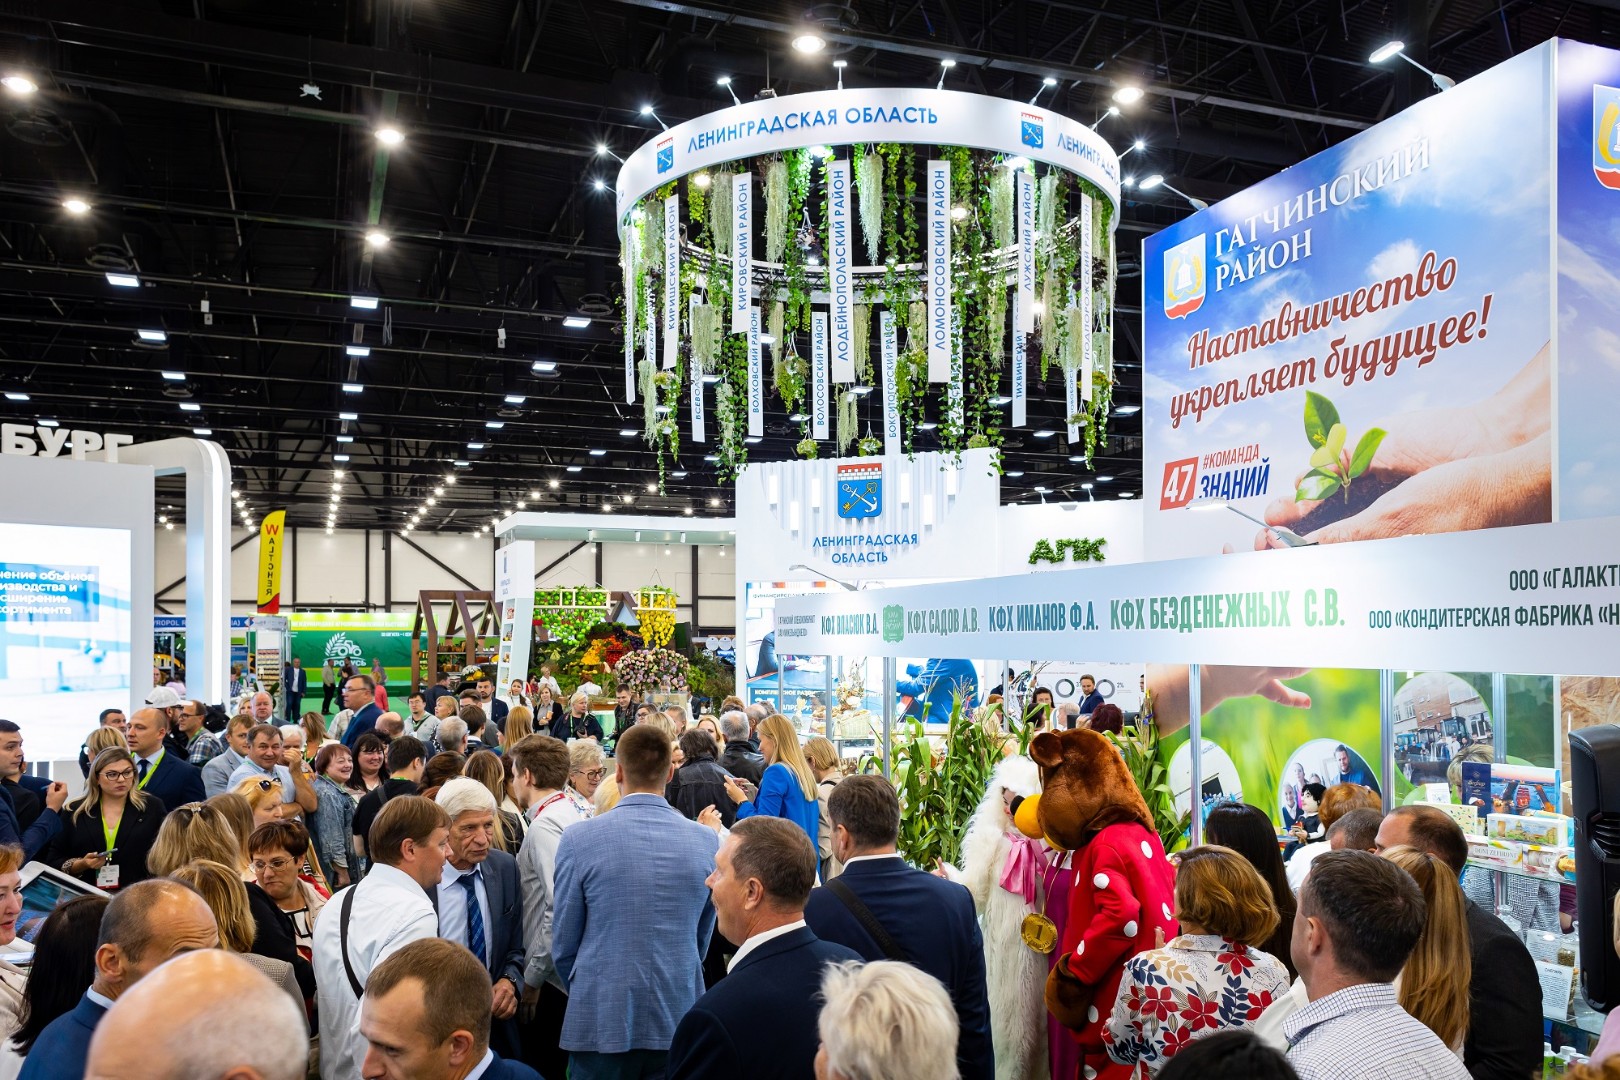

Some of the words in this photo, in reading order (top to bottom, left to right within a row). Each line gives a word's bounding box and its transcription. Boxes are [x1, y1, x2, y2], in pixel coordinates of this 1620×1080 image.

[687, 108, 838, 154] ЛЕНИНГРАДСКАЯ
[850, 105, 939, 125] ОБЛАСТЬ
[1057, 132, 1119, 186] ЛЕНИНГРАД
[737, 182, 748, 226] РАЙОН
[831, 170, 845, 217] РАЙОН
[932, 170, 945, 217] РАЙОН
[1023, 182, 1031, 226] РАЙОН
[1214, 136, 1432, 258] ГАТЧИНСКИЙ
[667, 205, 676, 249] РАЙОН
[737, 232, 748, 311] КИРОВСКИЙ
[1023, 229, 1031, 292] ЛУЖСКИЙ
[1214, 227, 1313, 293] РАЙОН
[667, 252, 676, 330] КИРИШСКИЙ
[832, 220, 849, 362] ЛОДЕЙНОПОЛЬСКИЙ
[932, 221, 946, 351] ЛОМОНОСОВСКИЙ
[750, 313, 759, 346] РАЙОН
[1187, 250, 1458, 369] Наставничество
[814, 318, 824, 350] РАЙОН
[750, 348, 759, 413] ВОЛХОВСКИЙ
[1015, 335, 1023, 399] ТИХВИНСКИЙ
[1169, 356, 1317, 430] укрепляет
[1323, 293, 1494, 388] будущее!
[814, 353, 825, 426] ВОЛОСОВСКИЙ
[885, 352, 896, 438] БОКСИТОГОРСКИЙ
[1, 422, 134, 463] БУРГ
[1202, 443, 1260, 470] #КОМАНДА
[1163, 463, 1195, 503] 47
[1199, 457, 1271, 501] ЗНАНИЙ
[812, 533, 919, 548] ЛЕНИНГРАДСКАЯ
[831, 551, 889, 564] ОБЛАСТЬ
[1028, 536, 1108, 566] АПК
[39, 570, 96, 582] объёмов
[69, 584, 78, 593] и
[1509, 569, 1539, 591] ООО
[154, 619, 179, 627] ROPOL
[821, 615, 836, 636] КФХ
[836, 613, 865, 636] ВЛАСЮК
[866, 612, 880, 635] В.А.
[907, 610, 927, 634] КФХ
[928, 608, 960, 637] САДОВ
[961, 606, 981, 633] А.В.
[988, 605, 1014, 632] КФХ
[1016, 602, 1066, 632] ИМАНОВ
[1069, 600, 1099, 631] Ф.А.
[1110, 598, 1146, 630] КФХ
[1149, 590, 1292, 633] БЕЗДЕНЕЖНЫХ
[1303, 588, 1346, 627] С.В.
[1368, 610, 1392, 629] ООО
[1395, 606, 1511, 630] «КОНДИТЕРСКАЯ
[1514, 603, 1594, 627] ФАБРИКА
